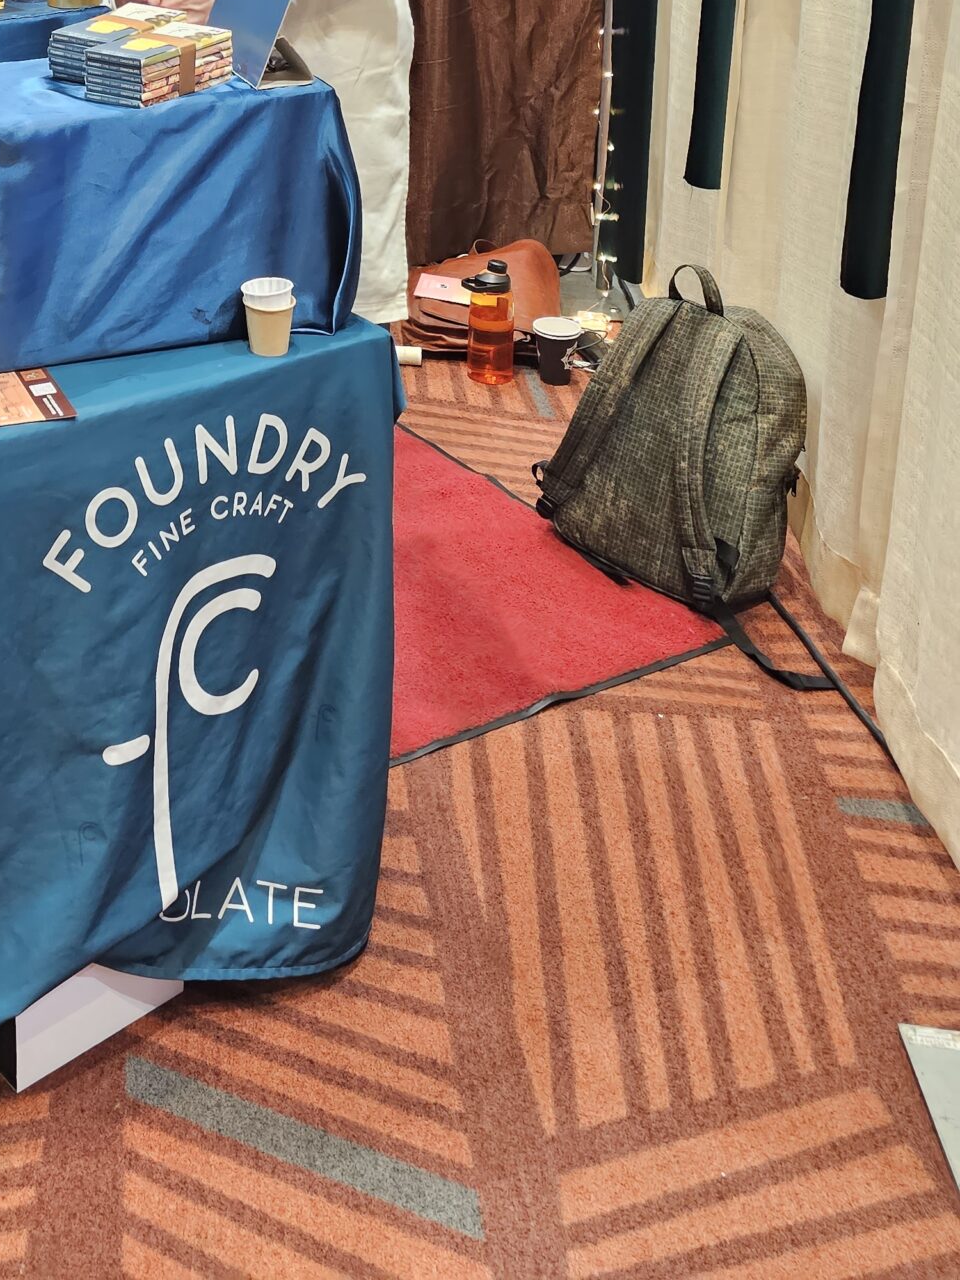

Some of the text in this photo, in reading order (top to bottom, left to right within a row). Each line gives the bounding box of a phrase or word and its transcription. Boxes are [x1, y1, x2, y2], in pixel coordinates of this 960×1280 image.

[42, 412, 367, 594] FOUNDRY
[131, 491, 295, 578] FINE CRAFT
